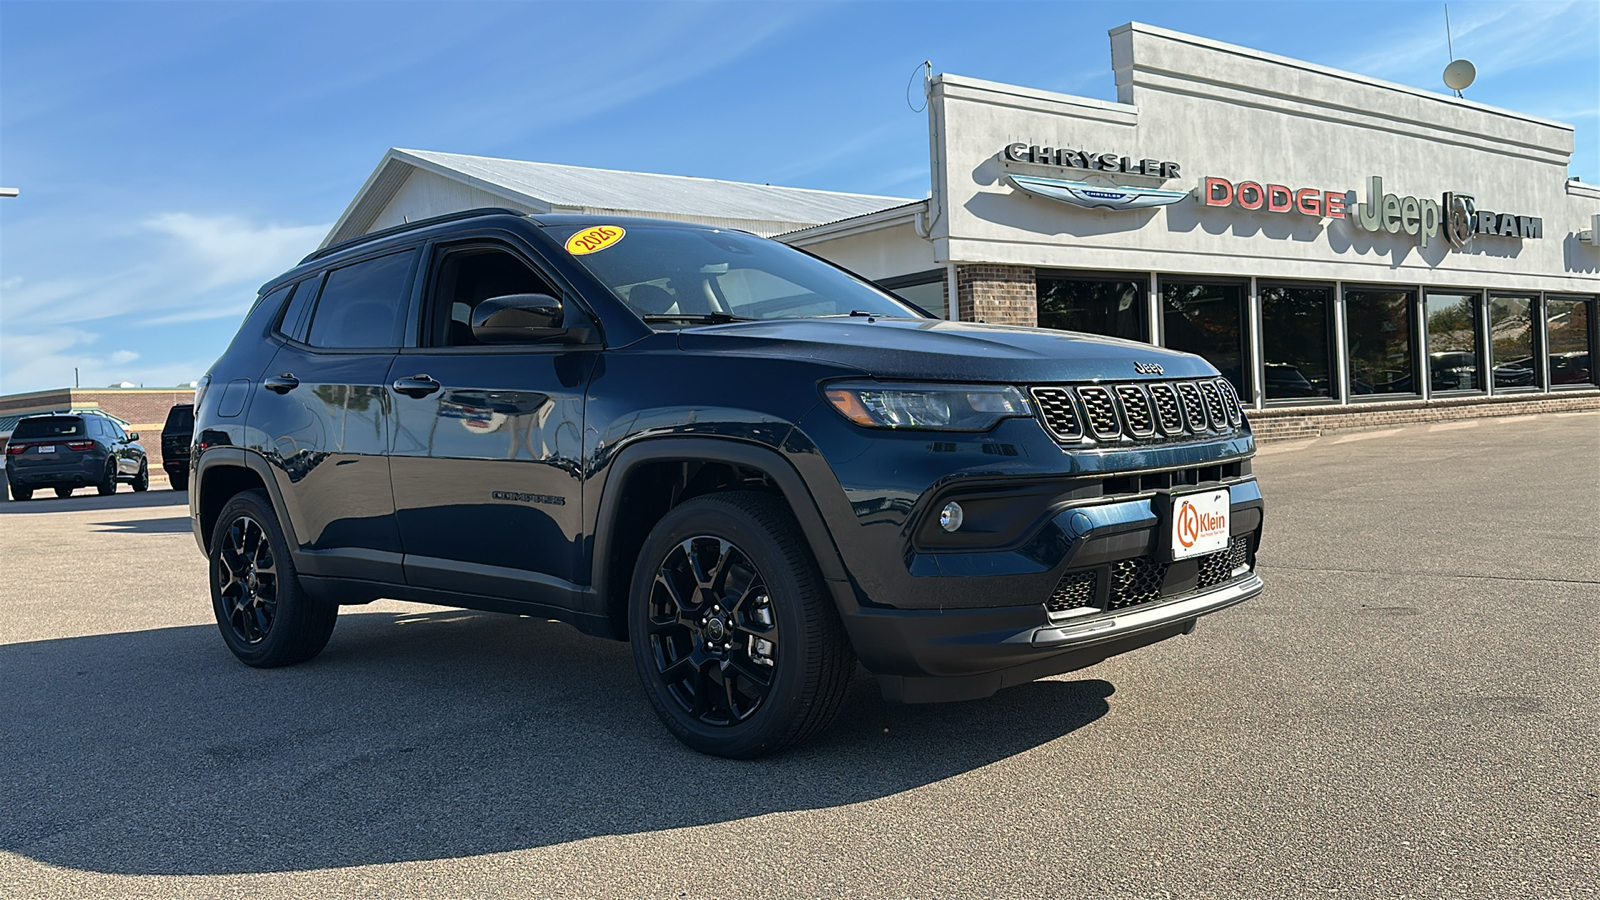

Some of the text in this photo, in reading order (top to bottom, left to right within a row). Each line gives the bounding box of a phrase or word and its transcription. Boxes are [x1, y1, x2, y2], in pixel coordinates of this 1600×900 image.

[1005, 142, 1182, 179] CHRYSLER
[1204, 176, 1347, 219] DODGE
[1354, 176, 1439, 248] Jeep
[1476, 210, 1543, 239] RAM
[574, 227, 617, 251] 2026
[1133, 360, 1164, 376] Jeep
[491, 491, 566, 506] COMPASS
[1199, 511, 1226, 533] Klein
